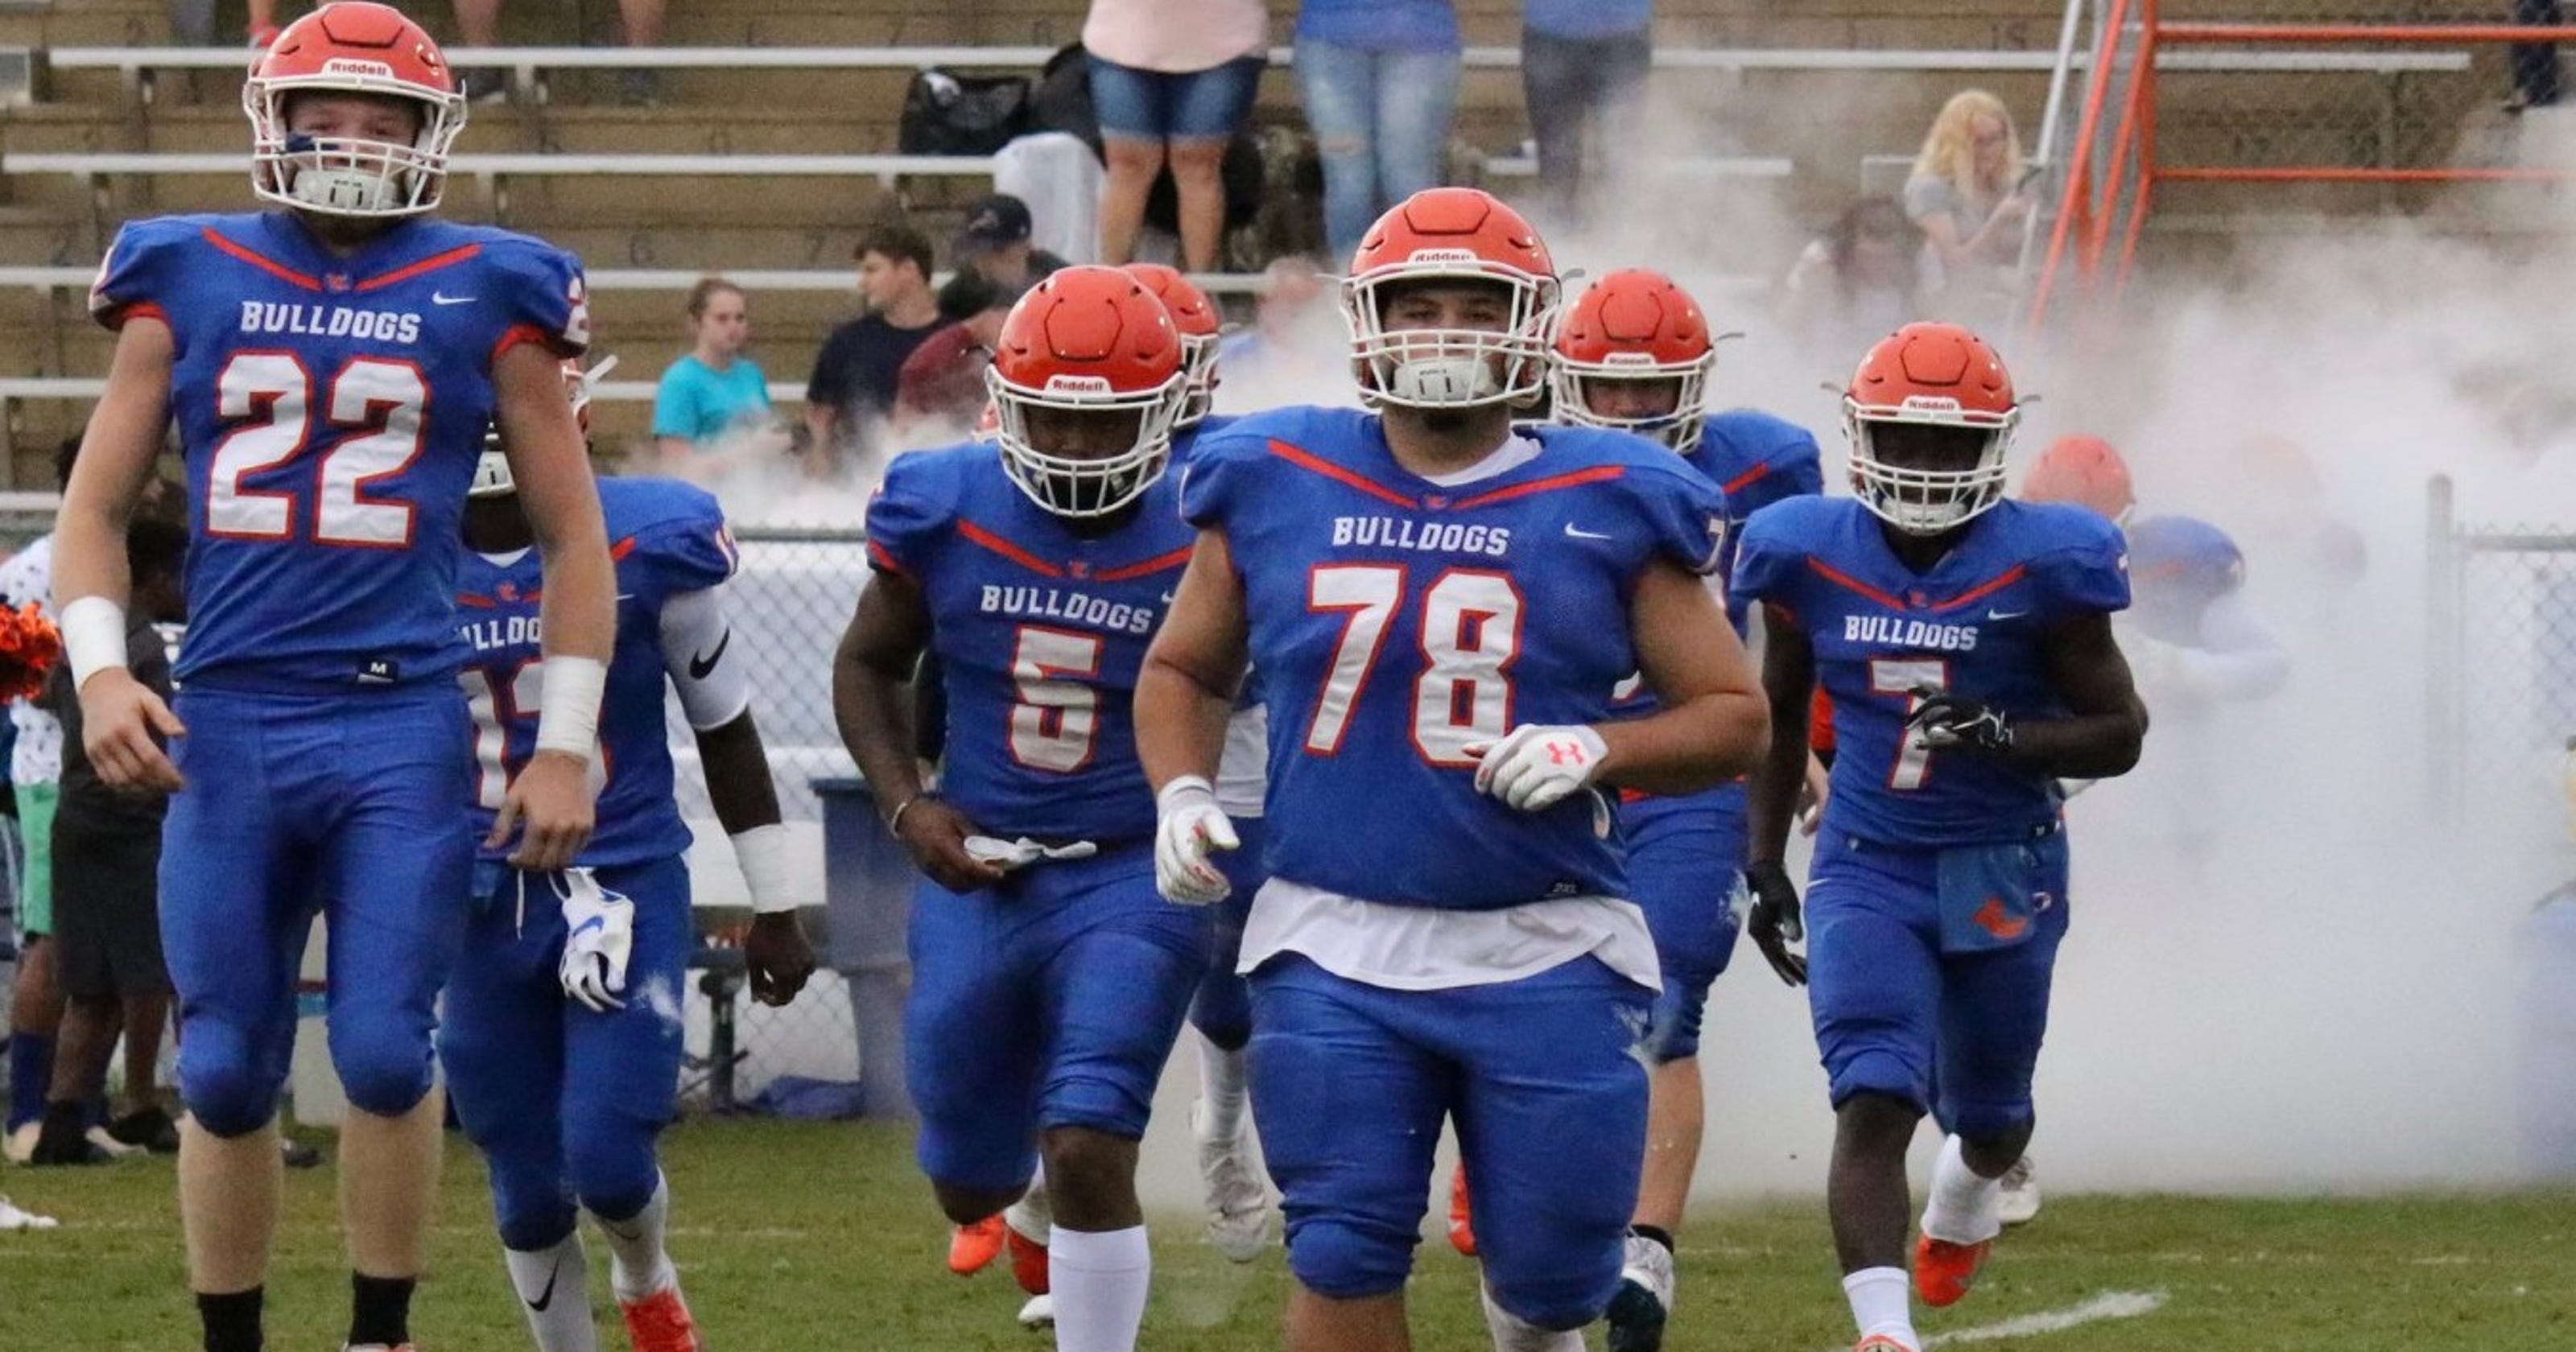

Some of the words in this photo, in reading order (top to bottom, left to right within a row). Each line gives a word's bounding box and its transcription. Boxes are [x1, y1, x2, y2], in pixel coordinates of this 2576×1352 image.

[330, 62, 386, 75] Riddell
[241, 299, 421, 344] BULLDOGS
[1052, 379, 1105, 391] Riddell
[208, 348, 432, 549] 22
[1332, 516, 1511, 557] BULLDOGS
[980, 584, 1154, 634] BULLDOGS
[1844, 615, 1977, 652] BULLDOGS
[370, 662, 386, 674] M
[1304, 563, 1525, 768] 78
[1008, 624, 1103, 776] 5
[1869, 657, 1951, 794] 7
